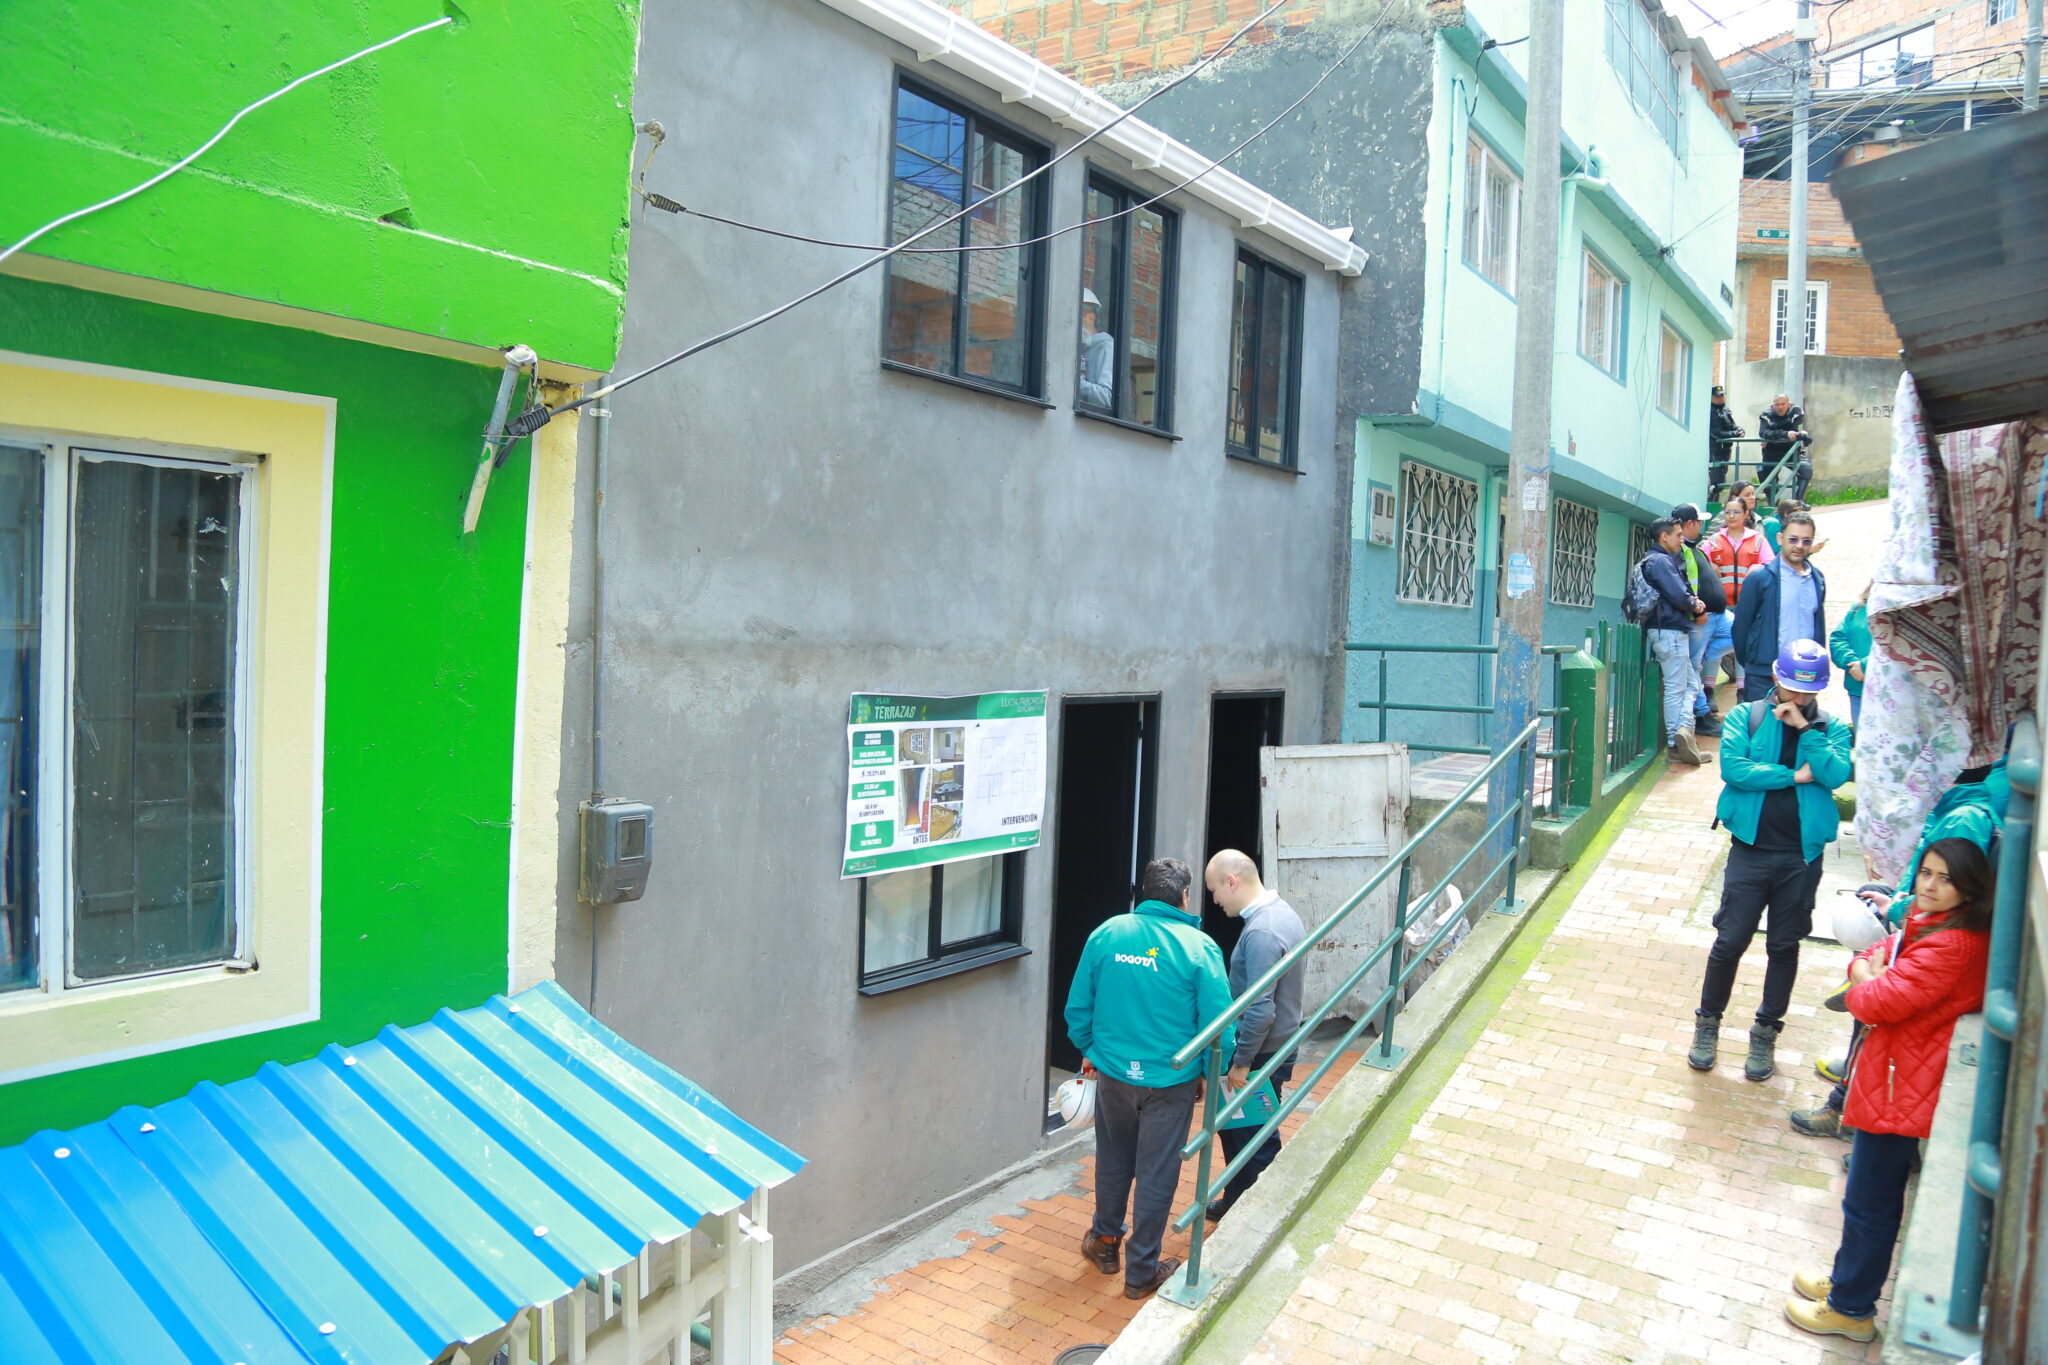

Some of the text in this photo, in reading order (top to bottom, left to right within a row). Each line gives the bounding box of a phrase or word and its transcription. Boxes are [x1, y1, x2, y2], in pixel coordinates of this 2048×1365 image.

[875, 697, 891, 705] PLAN
[874, 705, 916, 720] TERRAZAS
[1001, 812, 1038, 826] INTERVENCIÓN
[913, 834, 928, 845] ANTES
